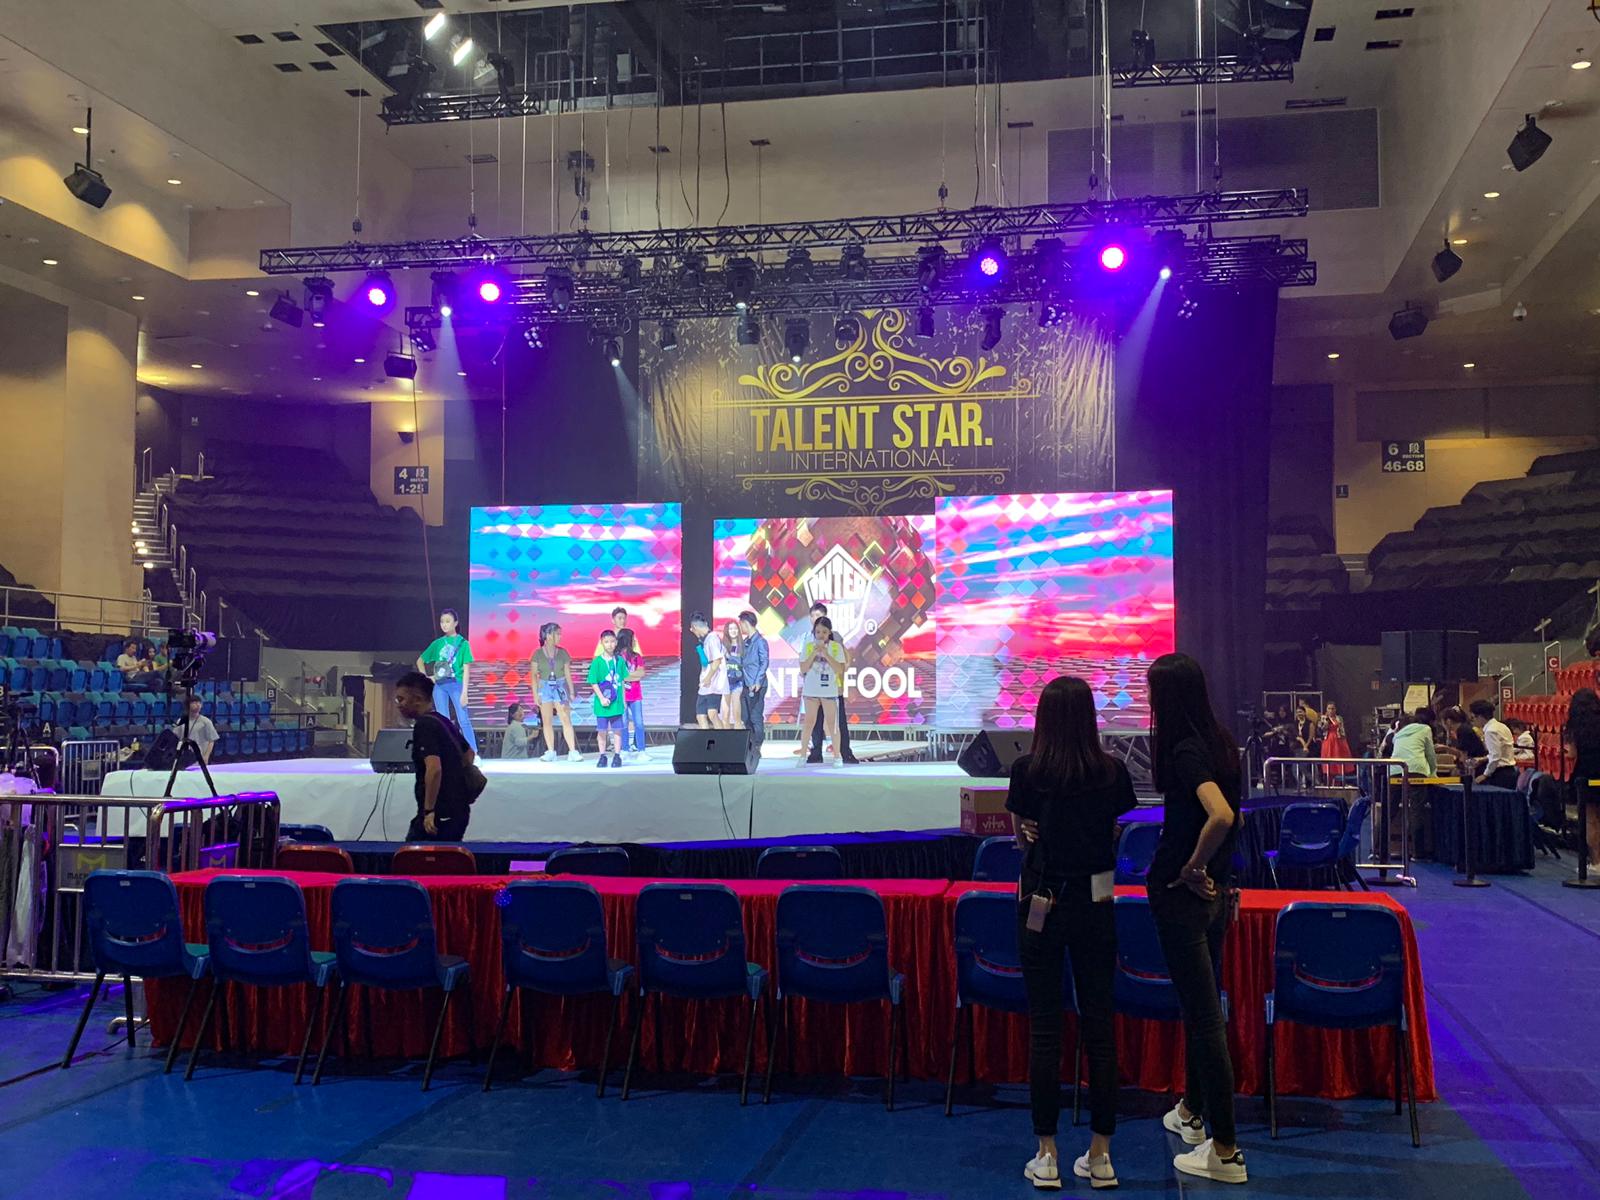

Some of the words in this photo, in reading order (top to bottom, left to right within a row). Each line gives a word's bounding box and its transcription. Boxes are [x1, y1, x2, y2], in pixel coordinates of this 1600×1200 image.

[750, 405, 880, 452] TALENT
[892, 402, 993, 449] STAR.
[1388, 443, 1399, 456] 6
[790, 449, 954, 471] INTERNATIONAL
[1383, 460, 1425, 472] 46-68
[399, 468, 408, 479] 4
[399, 484, 424, 494] 1-25
[1549, 658, 1558, 668] C
[268, 689, 275, 698] B
[1503, 689, 1512, 699] B
[306, 717, 314, 726] A
[43, 722, 51, 733] A
